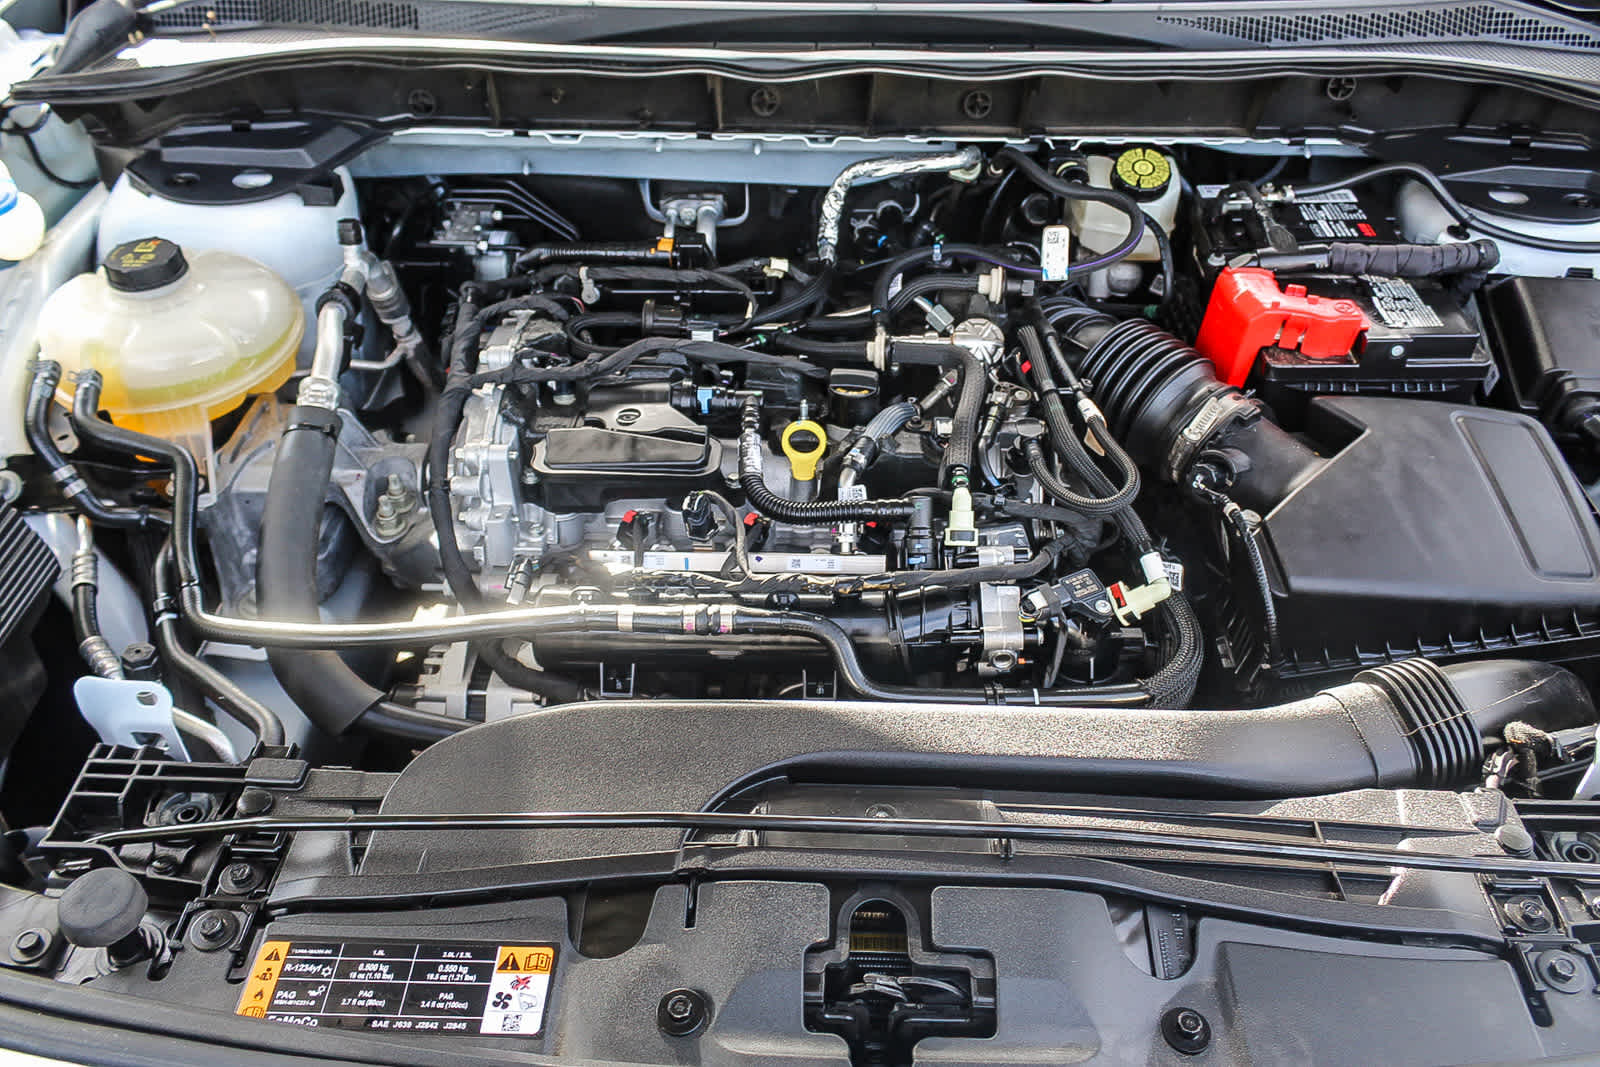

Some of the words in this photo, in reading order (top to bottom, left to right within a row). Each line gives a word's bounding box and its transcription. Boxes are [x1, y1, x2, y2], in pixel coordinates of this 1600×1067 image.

[284, 963, 323, 974] R-1234yf
[358, 963, 379, 971] 0.500
[379, 963, 390, 974] kg
[437, 964, 458, 973] 0.550
[458, 965, 469, 974] kg
[276, 991, 297, 999] PAG
[357, 990, 374, 998] PAG
[438, 992, 454, 1000] PAG
[341, 998, 351, 1006] 2.7
[371, 1020, 390, 1028] SAE
[392, 1020, 413, 1028] J639
